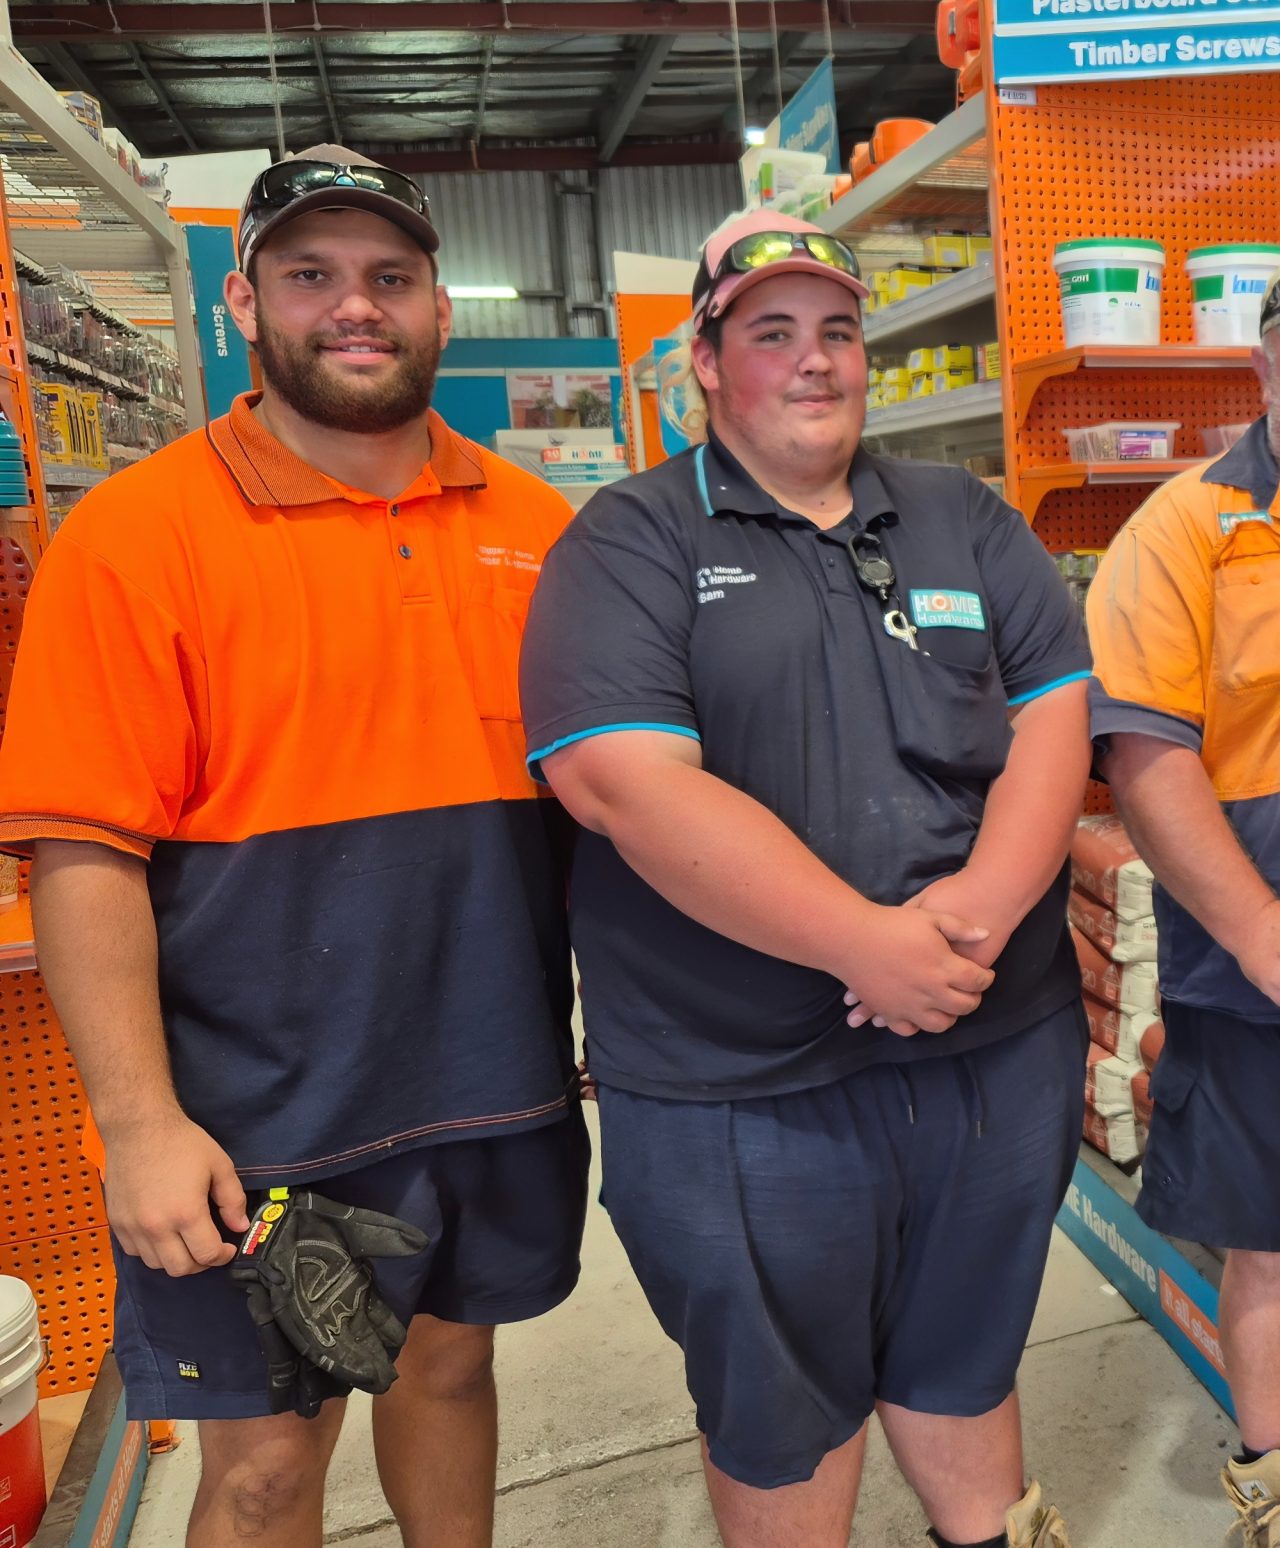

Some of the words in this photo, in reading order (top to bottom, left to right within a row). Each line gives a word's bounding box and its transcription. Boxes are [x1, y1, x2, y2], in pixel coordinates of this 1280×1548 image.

[1032, 0, 1218, 15] Plaster
[1069, 40, 1171, 67] Timber
[212, 305, 228, 357] Screws
[914, 592, 981, 616] HOME
[1083, 1194, 1157, 1293] Hardware
